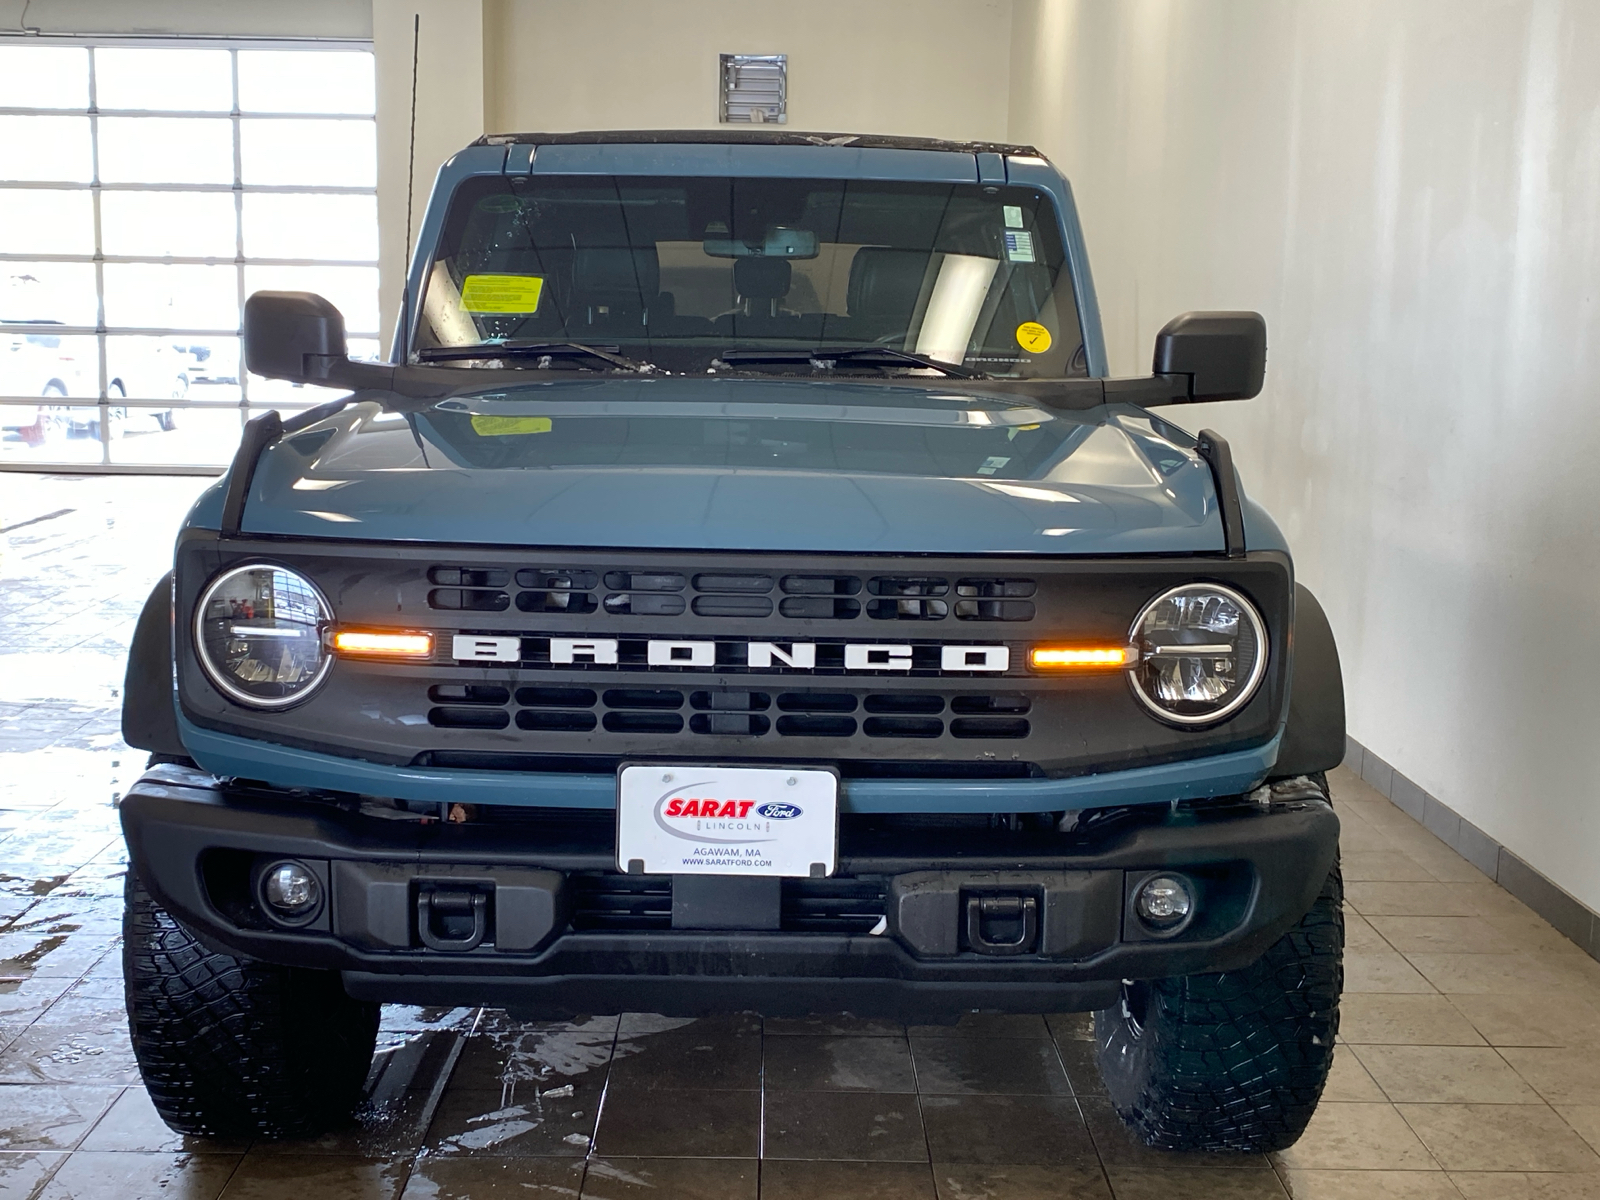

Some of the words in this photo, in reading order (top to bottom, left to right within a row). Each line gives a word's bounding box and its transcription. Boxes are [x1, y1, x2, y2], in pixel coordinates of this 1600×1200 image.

[452, 635, 1009, 671] BRONCO
[664, 798, 757, 819] SARAT
[764, 804, 795, 818] Ford
[706, 822, 762, 831] LINCOLN
[693, 848, 743, 858] AGAWAM,
[745, 849, 762, 857] MA
[682, 858, 773, 867] WWW.SARATFORD.COM
